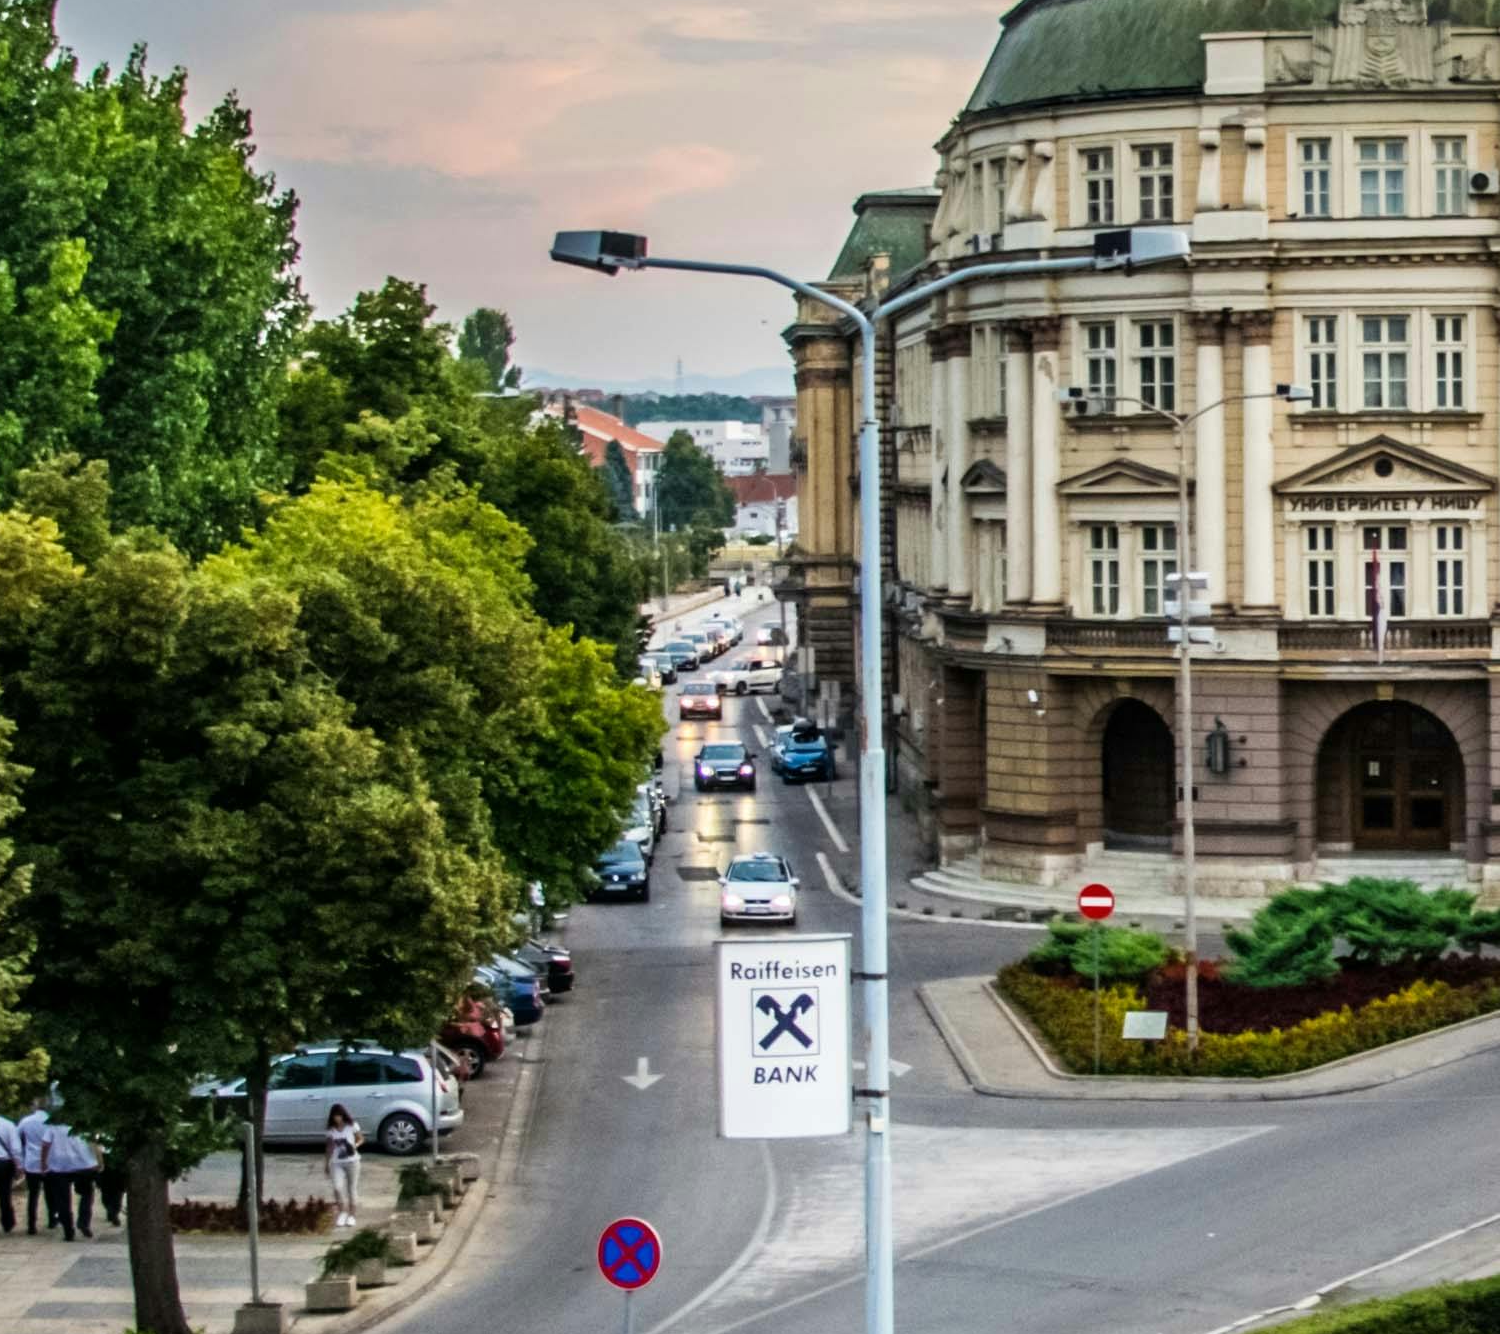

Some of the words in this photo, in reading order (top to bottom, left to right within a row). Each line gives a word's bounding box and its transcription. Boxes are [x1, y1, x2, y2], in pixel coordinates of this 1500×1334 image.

[1288, 496, 1413, 512] УНИВЕРЗИТЕТ
[1415, 497, 1426, 511] У
[1430, 495, 1483, 511] НИШУ
[730, 960, 838, 980] Raiffeisen
[753, 1064, 820, 1085] BANK
